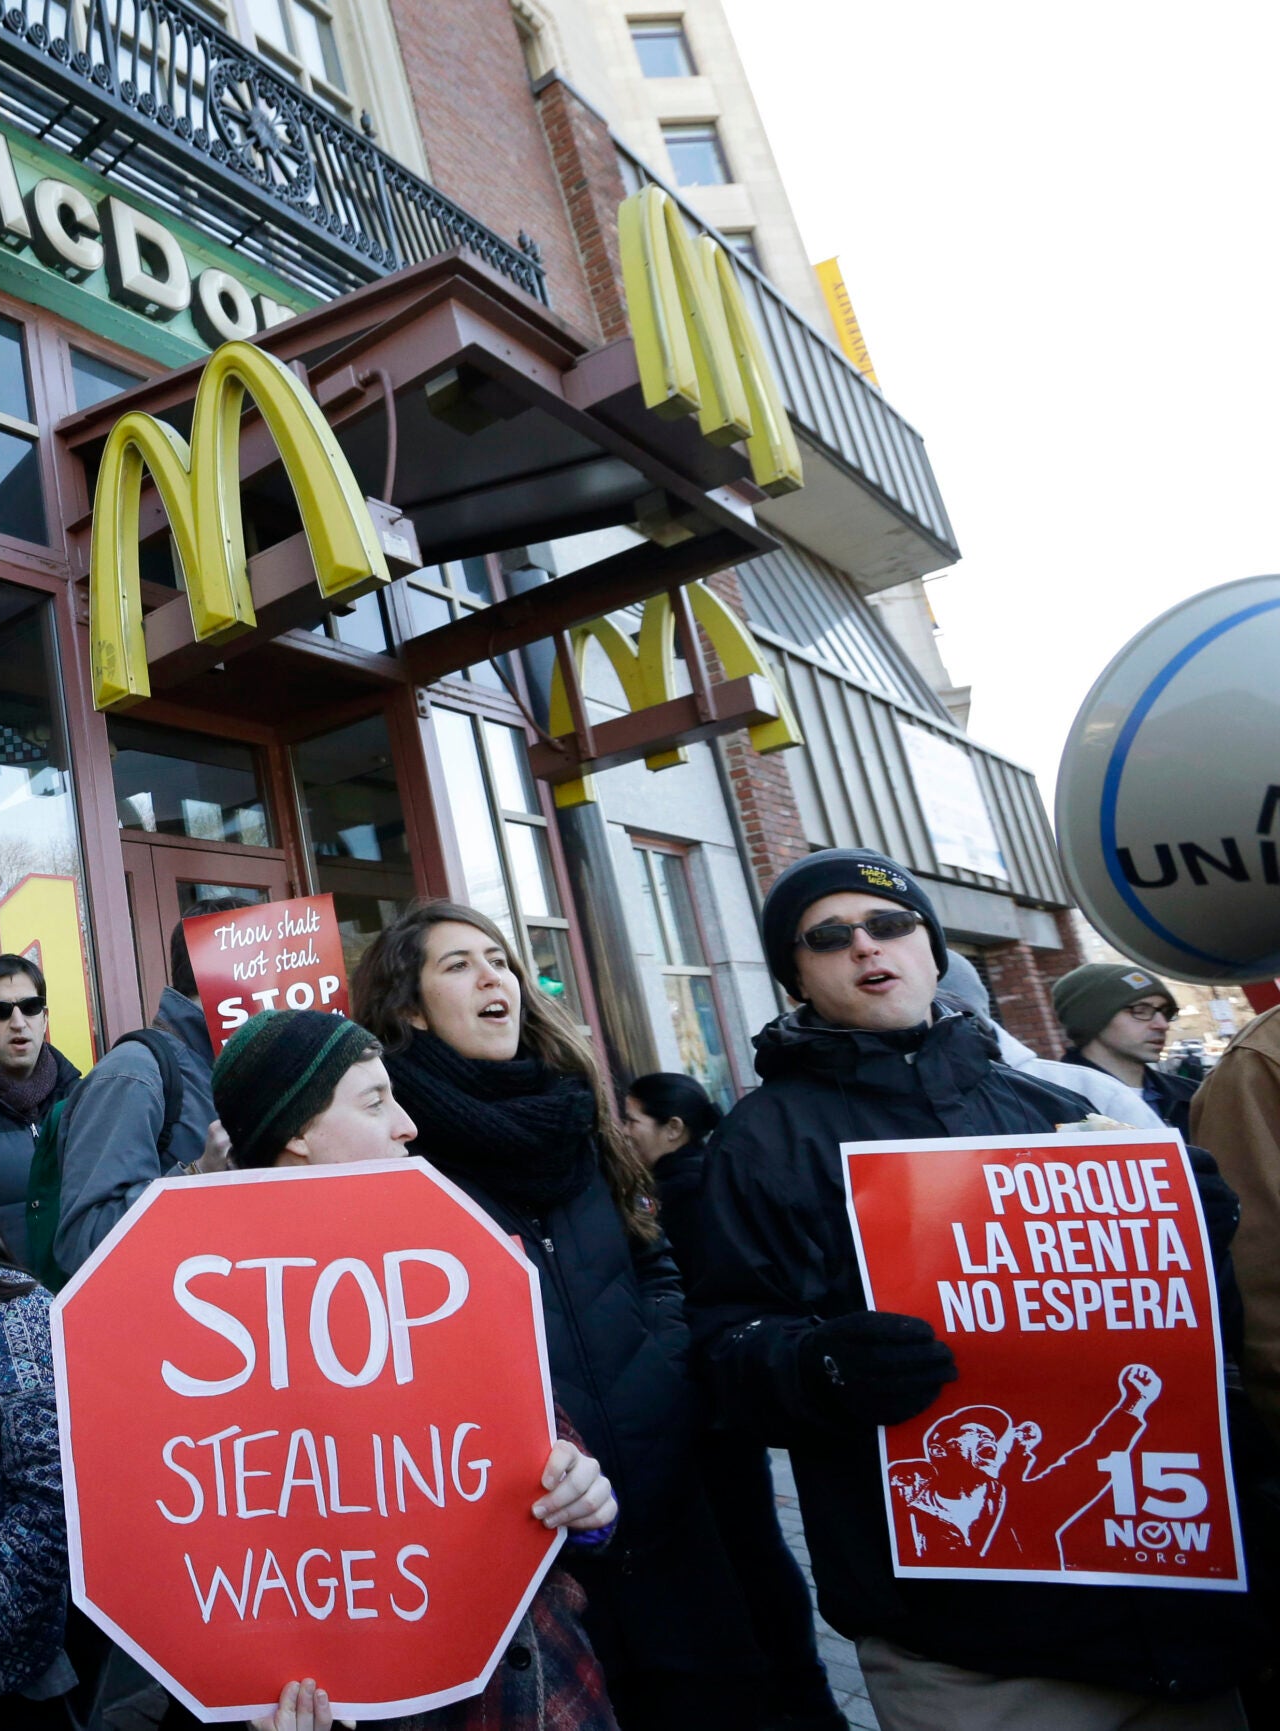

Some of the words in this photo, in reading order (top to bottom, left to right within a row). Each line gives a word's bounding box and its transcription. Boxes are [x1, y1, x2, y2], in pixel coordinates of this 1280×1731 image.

[214, 922, 272, 950] Thou
[277, 906, 321, 939] shalt
[233, 950, 270, 981] not
[275, 938, 320, 972] steal.
[216, 975, 341, 1029] STOP
[982, 1158, 1179, 1216] PORQUE
[951, 1221, 1020, 1274] LA
[1023, 1218, 1193, 1273] RENTA
[161, 1248, 470, 1397] STOP
[936, 1279, 1007, 1333] NO
[1012, 1276, 1199, 1332] ESPERA
[155, 1422, 492, 1525] STEALING
[1096, 1450, 1209, 1519] 15
[1103, 1518, 1211, 1552] NOW
[1123, 1551, 1187, 1565] .ORG
[183, 1544, 430, 1623] WAGES
